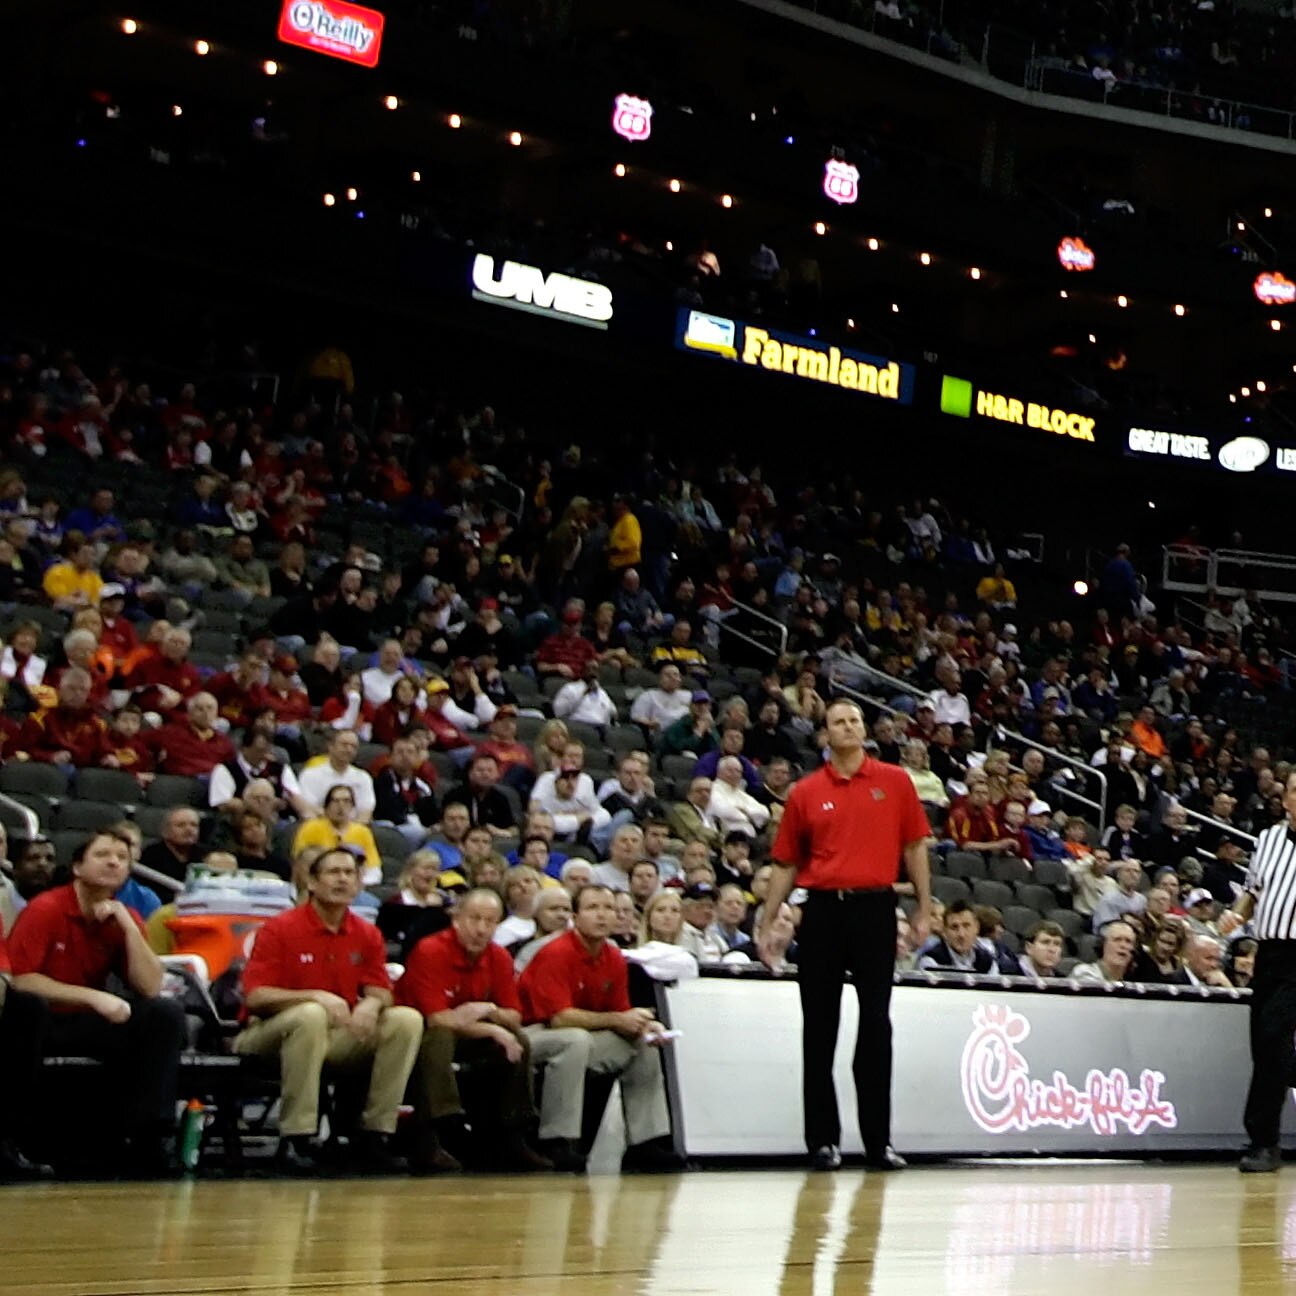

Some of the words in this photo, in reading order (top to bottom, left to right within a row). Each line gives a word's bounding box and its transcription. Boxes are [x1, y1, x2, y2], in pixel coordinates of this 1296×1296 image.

[472, 253, 613, 321] UMB
[742, 326, 899, 399] Farmland
[976, 390, 1024, 425] H&R
[1027, 402, 1096, 442] BLOCK
